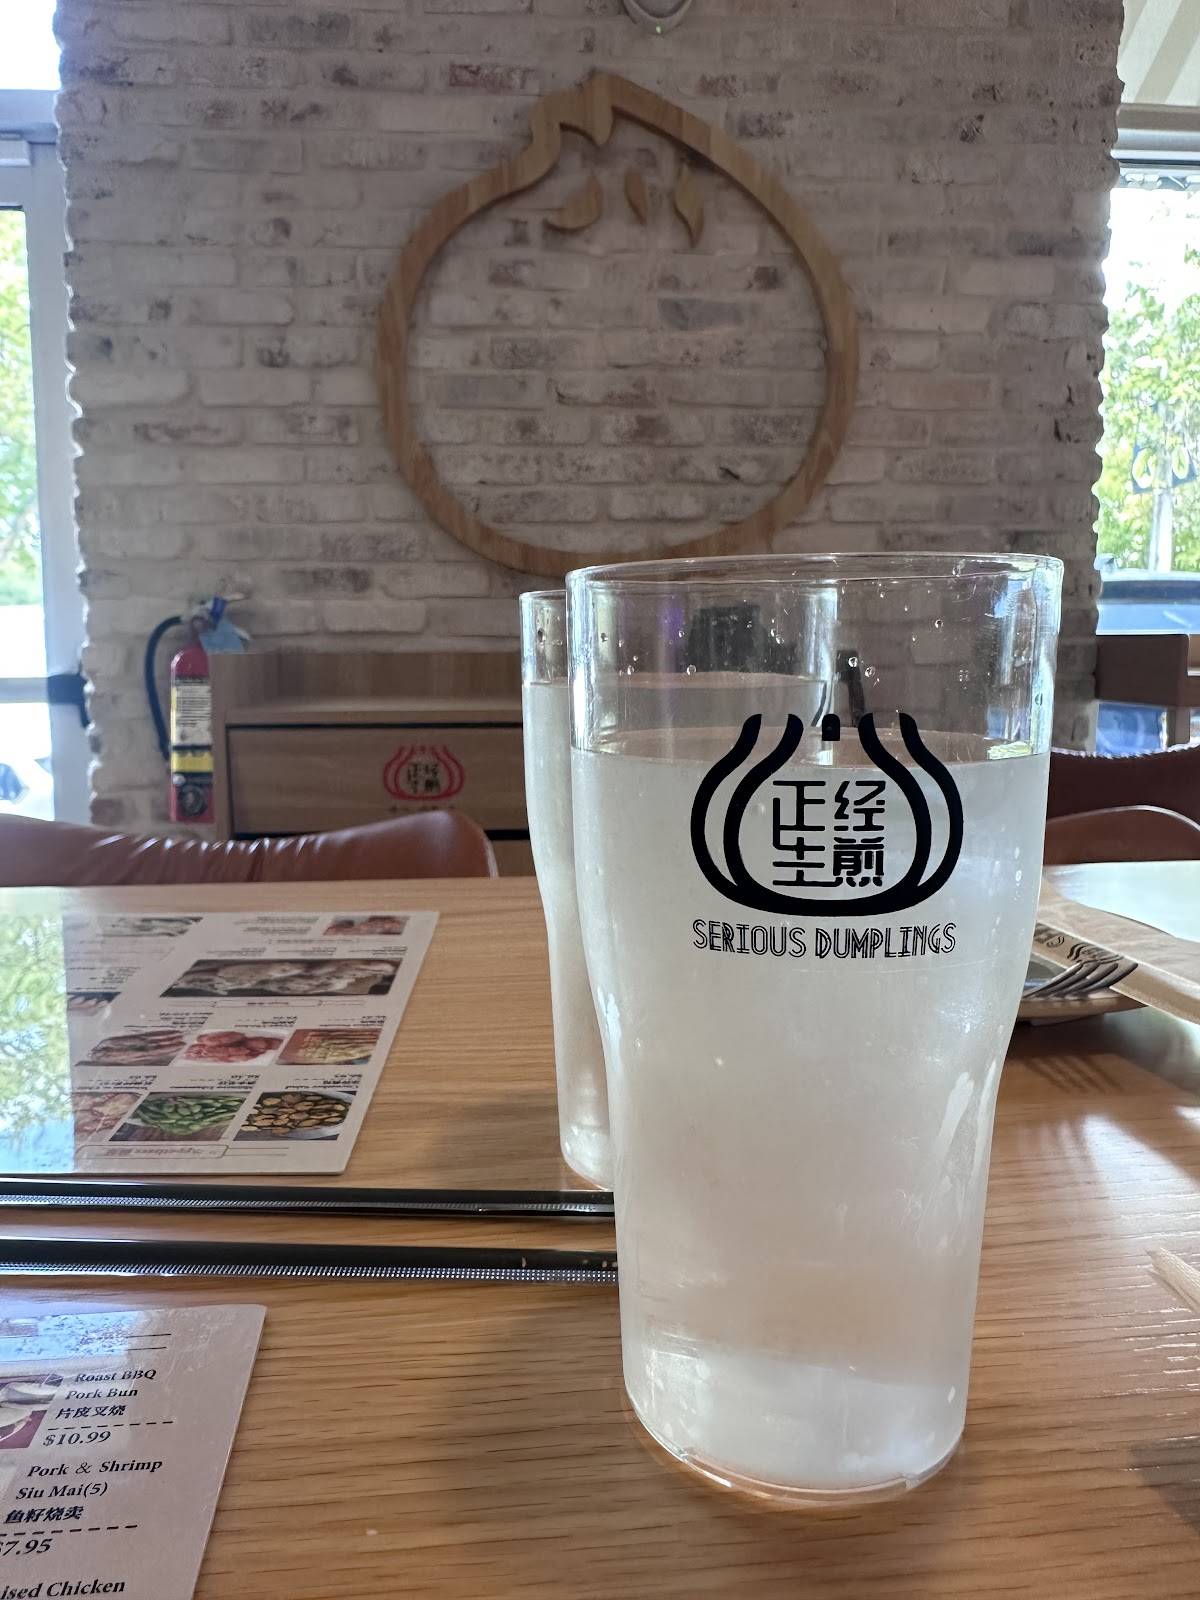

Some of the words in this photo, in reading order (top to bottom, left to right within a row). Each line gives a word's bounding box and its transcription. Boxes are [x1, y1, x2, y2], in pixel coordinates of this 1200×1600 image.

[772, 780, 886, 831] 正经
[772, 836, 885, 887] 生煎
[692, 919, 806, 957] SERIOUS
[815, 922, 957, 959] DUMPLINGS
[75, 1371, 117, 1383] Roast
[121, 1369, 157, 1381] BBQ
[65, 1388, 102, 1400] Pork
[106, 1388, 139, 1399] Bun
[43, 1431, 112, 1447] $10.99
[27, 1463, 70, 1477] Pork
[75, 1462, 93, 1475] &
[99, 1459, 163, 1473] Shrimp
[15, 1486, 44, 1500] Siu
[48, 1481, 109, 1499] Mai(5)
[46, 1578, 126, 1598] Chicken
